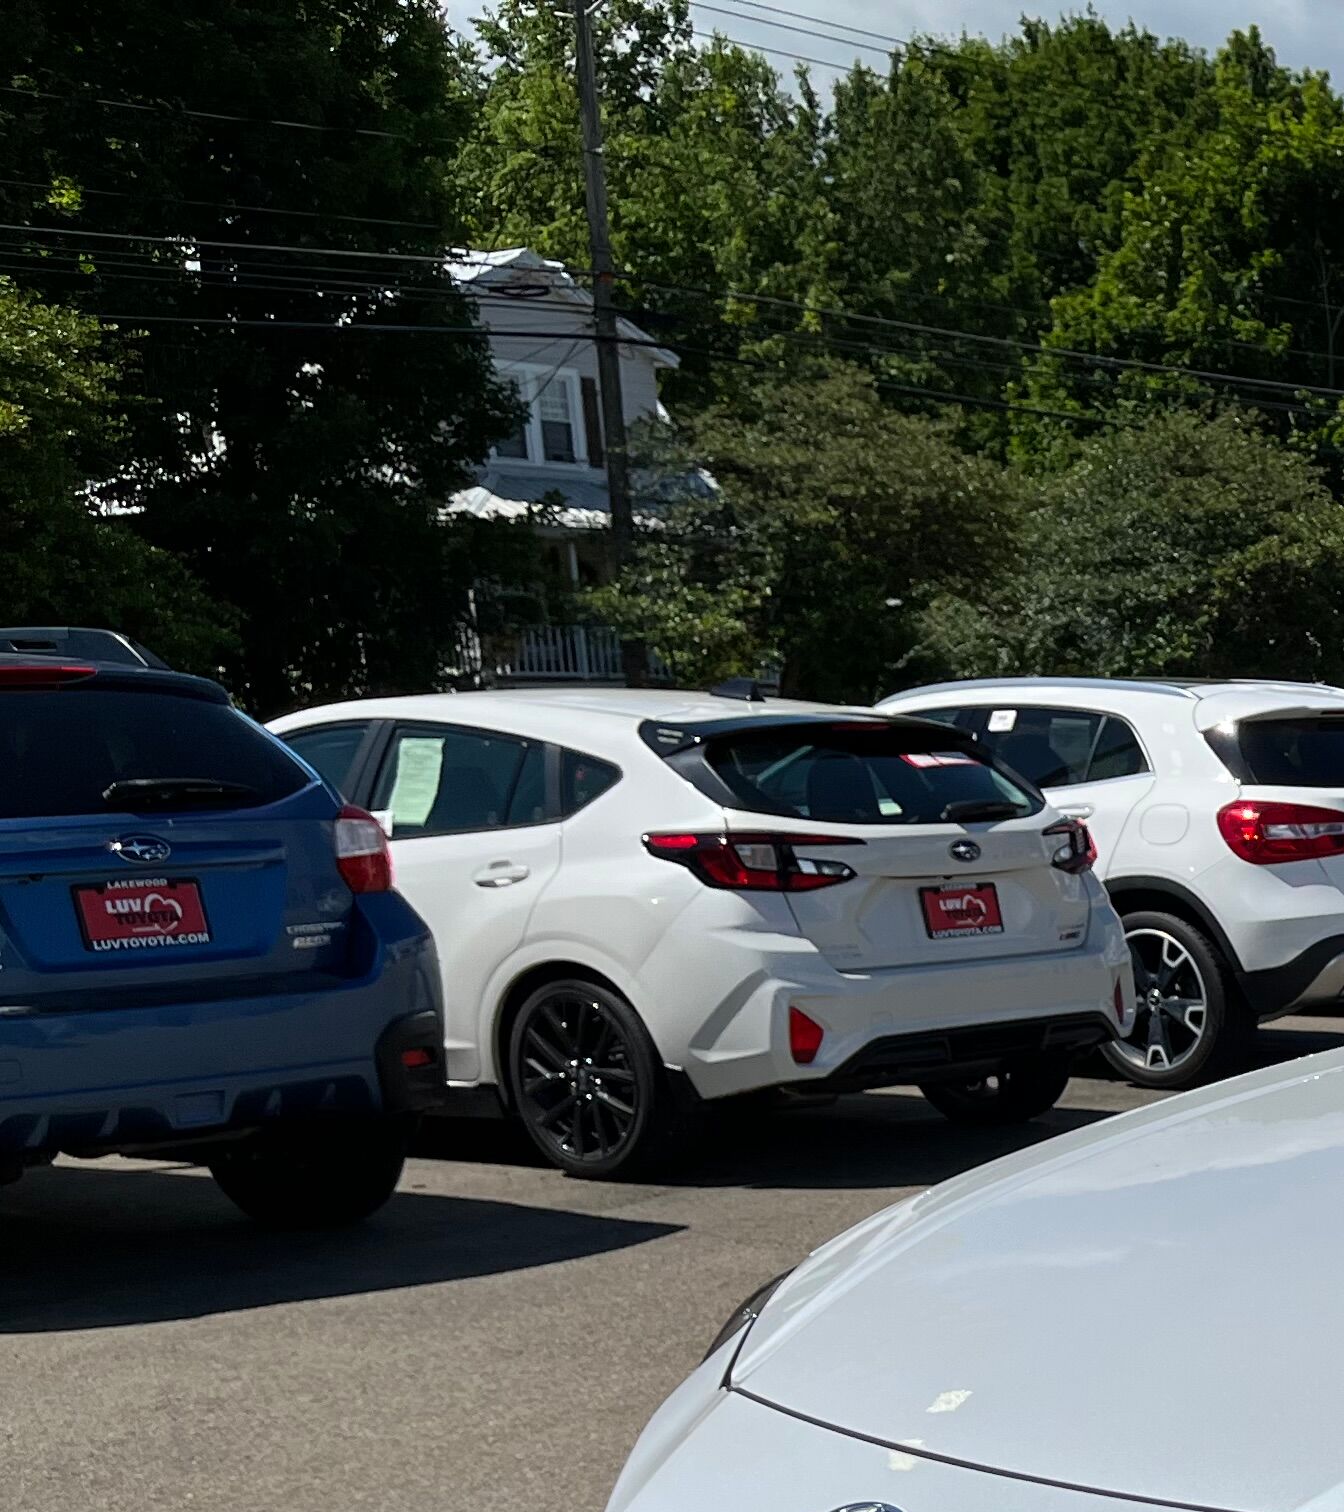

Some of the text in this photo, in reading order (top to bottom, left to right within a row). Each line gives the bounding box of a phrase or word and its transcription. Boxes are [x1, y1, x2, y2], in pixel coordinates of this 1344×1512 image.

[106, 878, 168, 891] LAKEWOOD
[105, 898, 141, 914] LUV
[939, 898, 962, 912] LUV
[92, 932, 210, 951] LUVTOYOTA.COM
